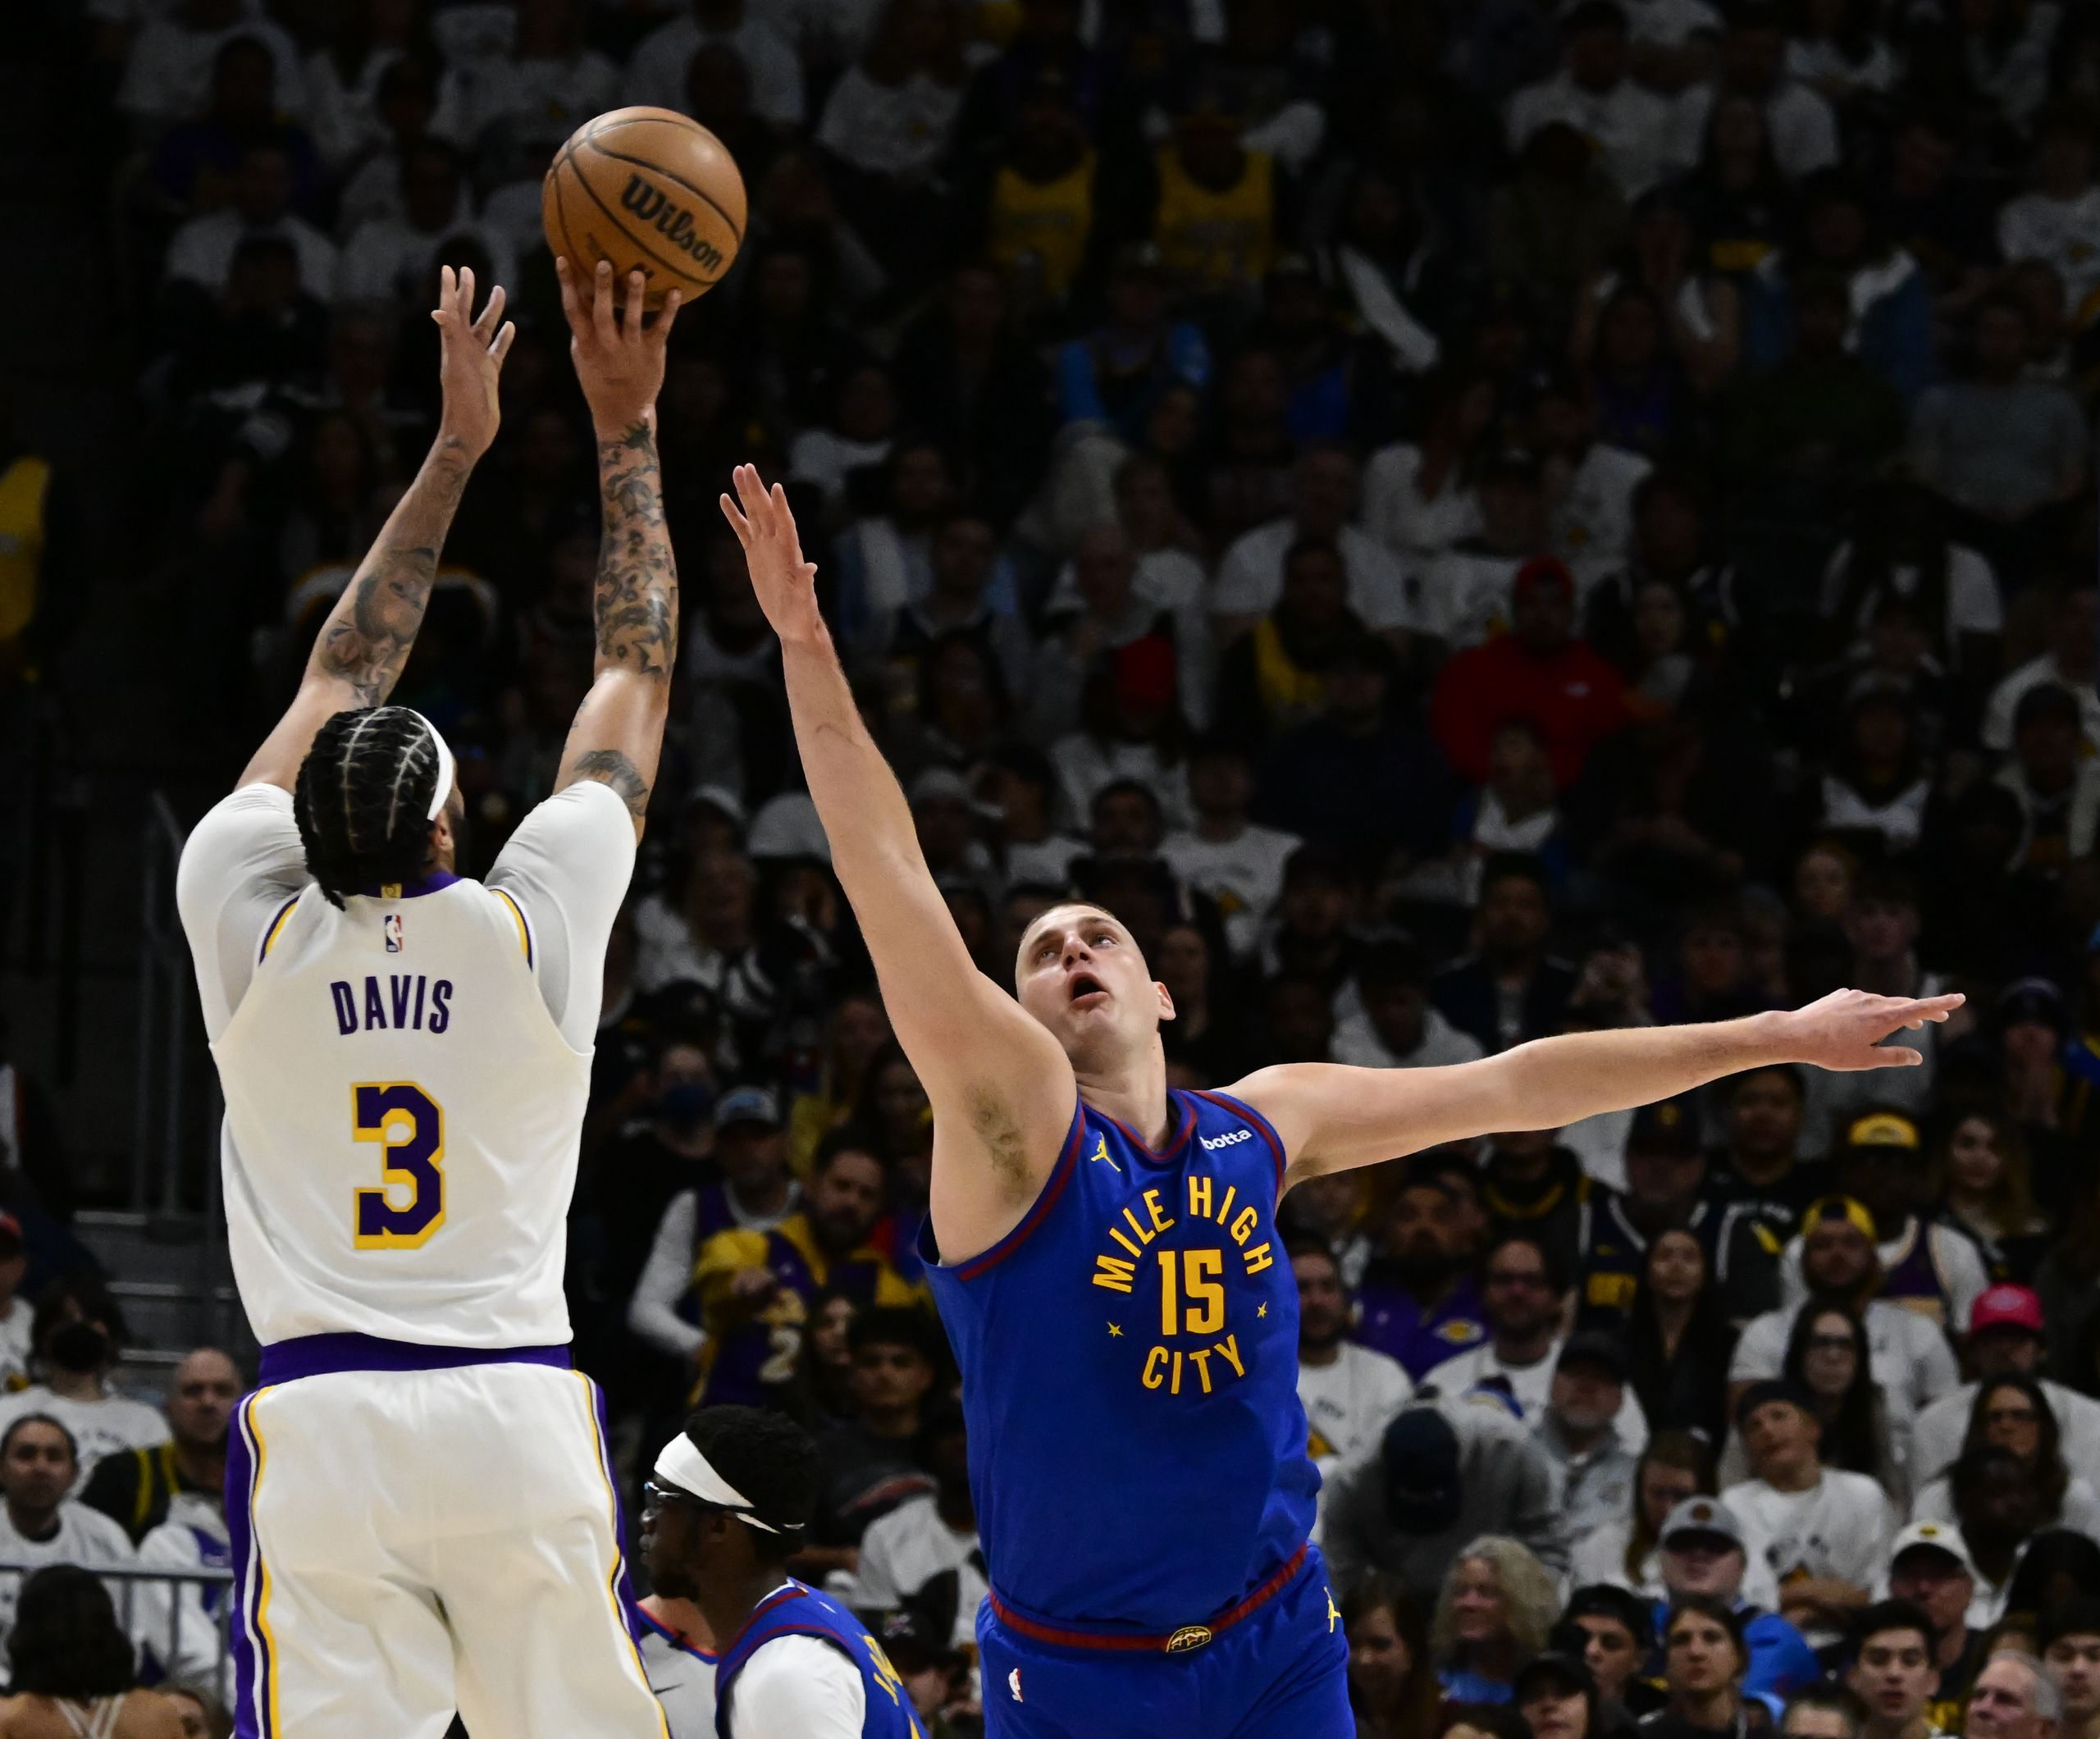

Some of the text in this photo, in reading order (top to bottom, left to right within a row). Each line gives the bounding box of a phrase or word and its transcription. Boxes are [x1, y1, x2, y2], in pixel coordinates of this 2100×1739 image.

[620, 173, 724, 274] Wilson
[330, 974, 454, 1036] DAVIS
[350, 1080, 447, 1251] 3
[1092, 1175, 1274, 1294] MILE HIGH
[1157, 1248, 1226, 1335] 15
[1141, 1334, 1245, 1395] CITY
